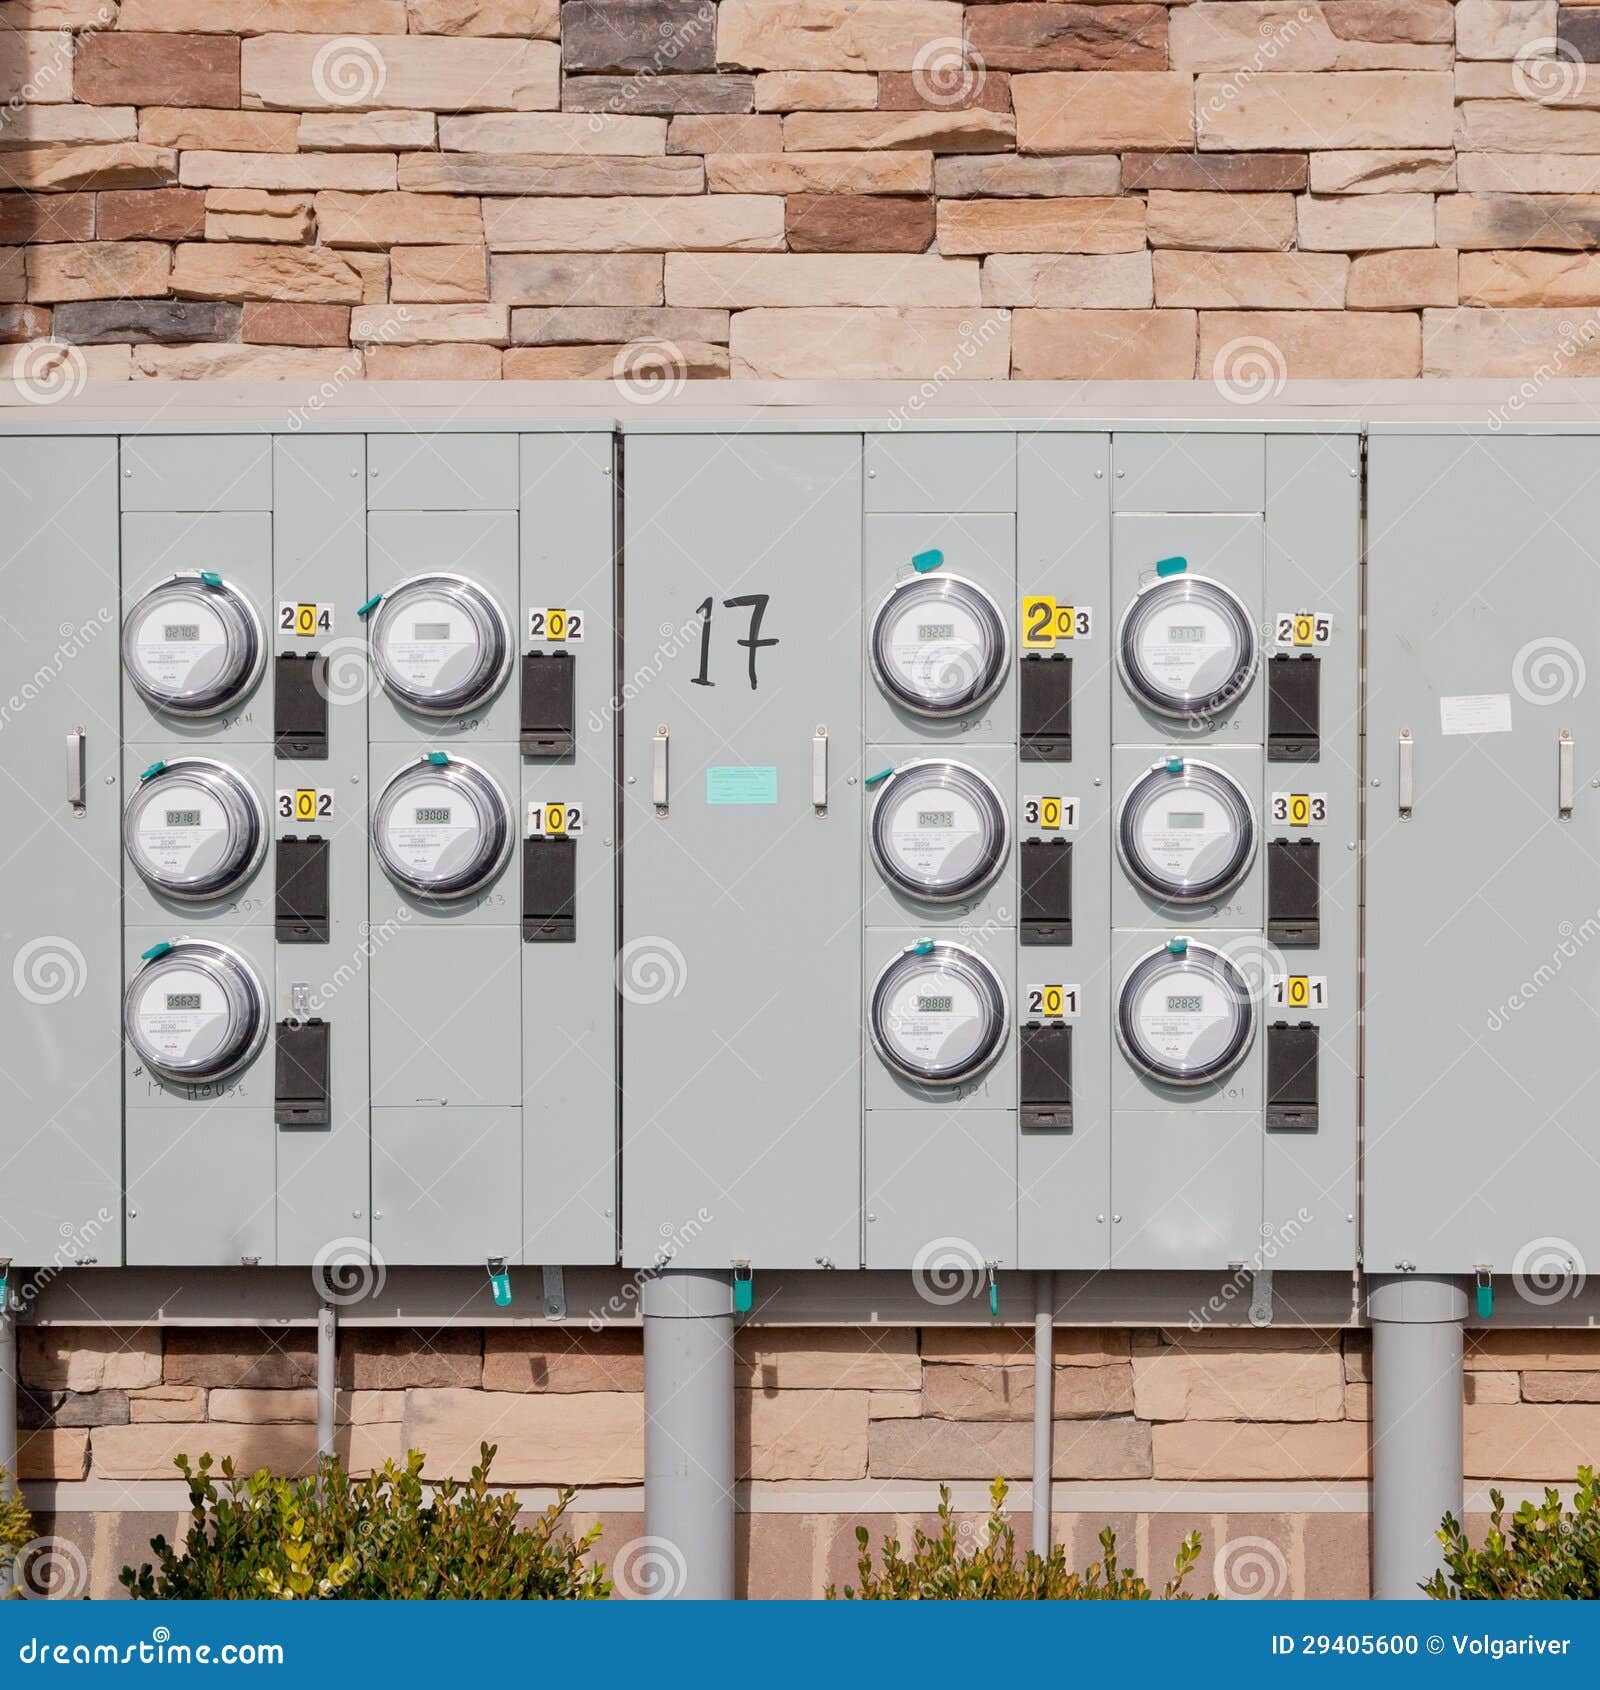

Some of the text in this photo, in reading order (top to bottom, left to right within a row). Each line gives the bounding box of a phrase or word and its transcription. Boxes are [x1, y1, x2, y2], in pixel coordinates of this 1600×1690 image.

[281, 606, 330, 630] 204
[531, 613, 581, 638] 202
[1027, 602, 1090, 641] 203
[1278, 619, 1329, 642] 205
[690, 594, 779, 690] 17
[279, 794, 332, 817] 302
[416, 809, 449, 821] 03008
[1025, 801, 1074, 825] 301
[1274, 798, 1325, 820] 303
[532, 808, 581, 830] 102
[919, 814, 952, 825] 04273
[1029, 991, 1076, 1012] 201
[1274, 981, 1322, 1003] 101
[1167, 998, 1201, 1010] 02825
